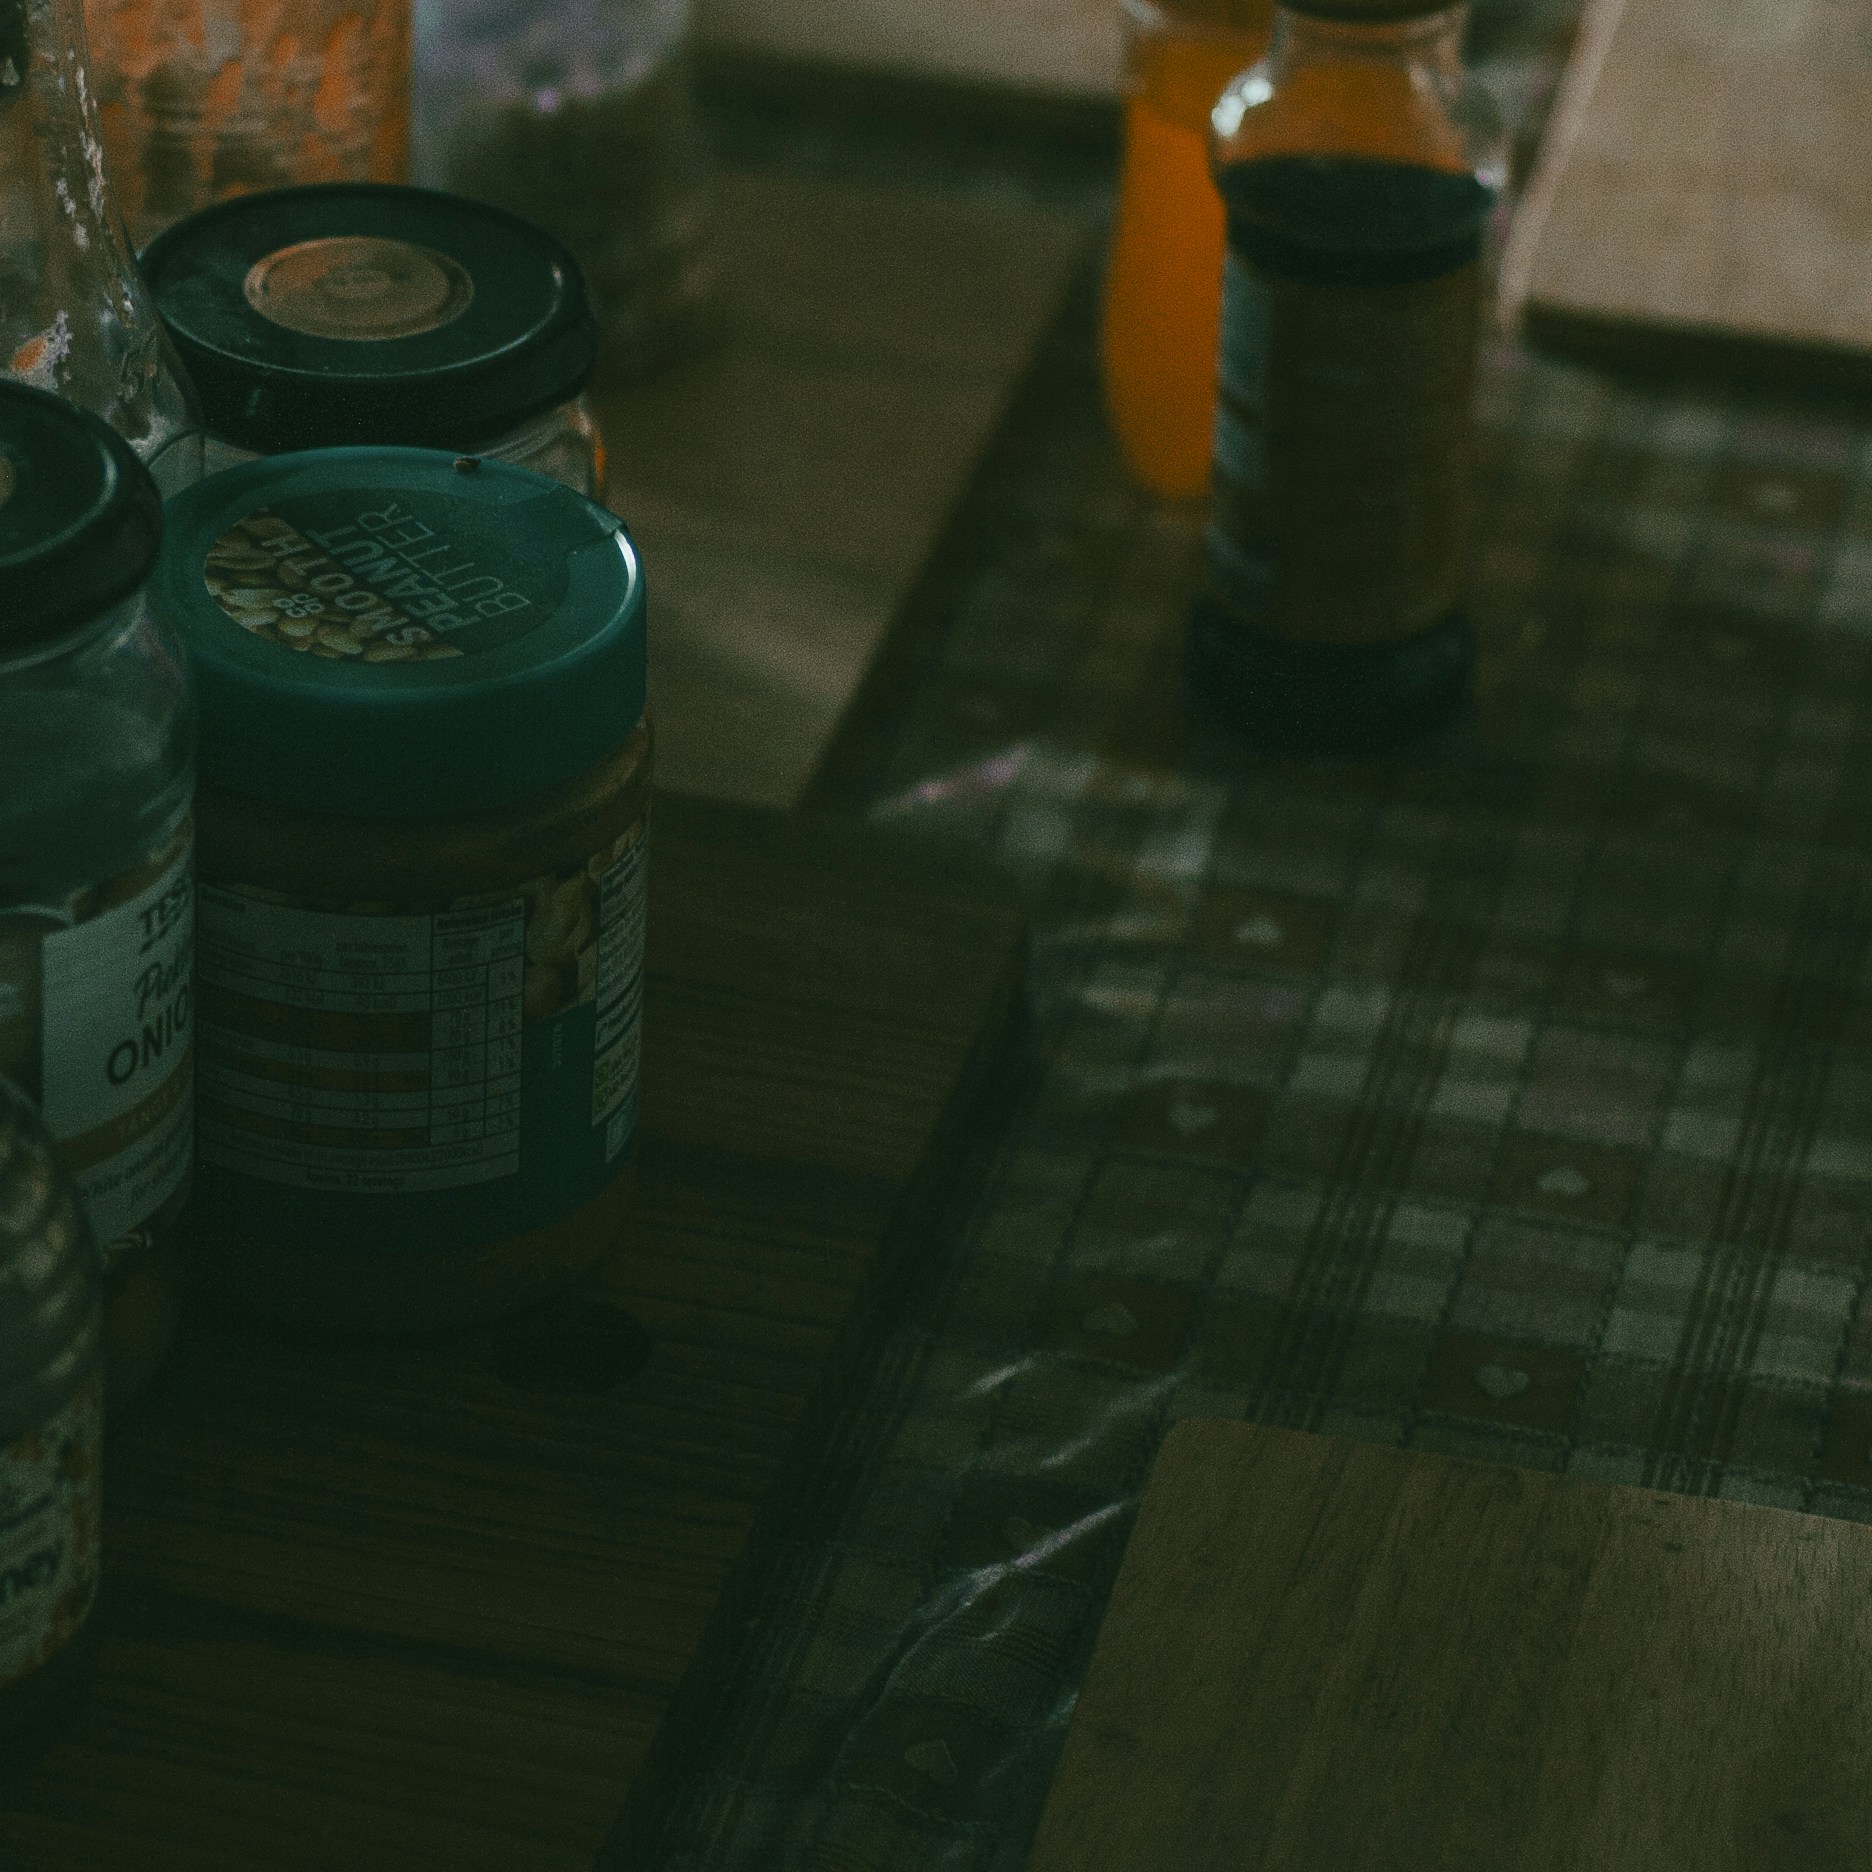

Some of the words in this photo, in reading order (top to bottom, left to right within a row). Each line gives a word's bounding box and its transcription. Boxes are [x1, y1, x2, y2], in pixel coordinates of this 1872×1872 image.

[260, 532, 434, 646] SMOOTH
[306, 524, 484, 632] PEANUT
[357, 502, 532, 618] BUTTER
[106, 985, 192, 1087] ONIO
